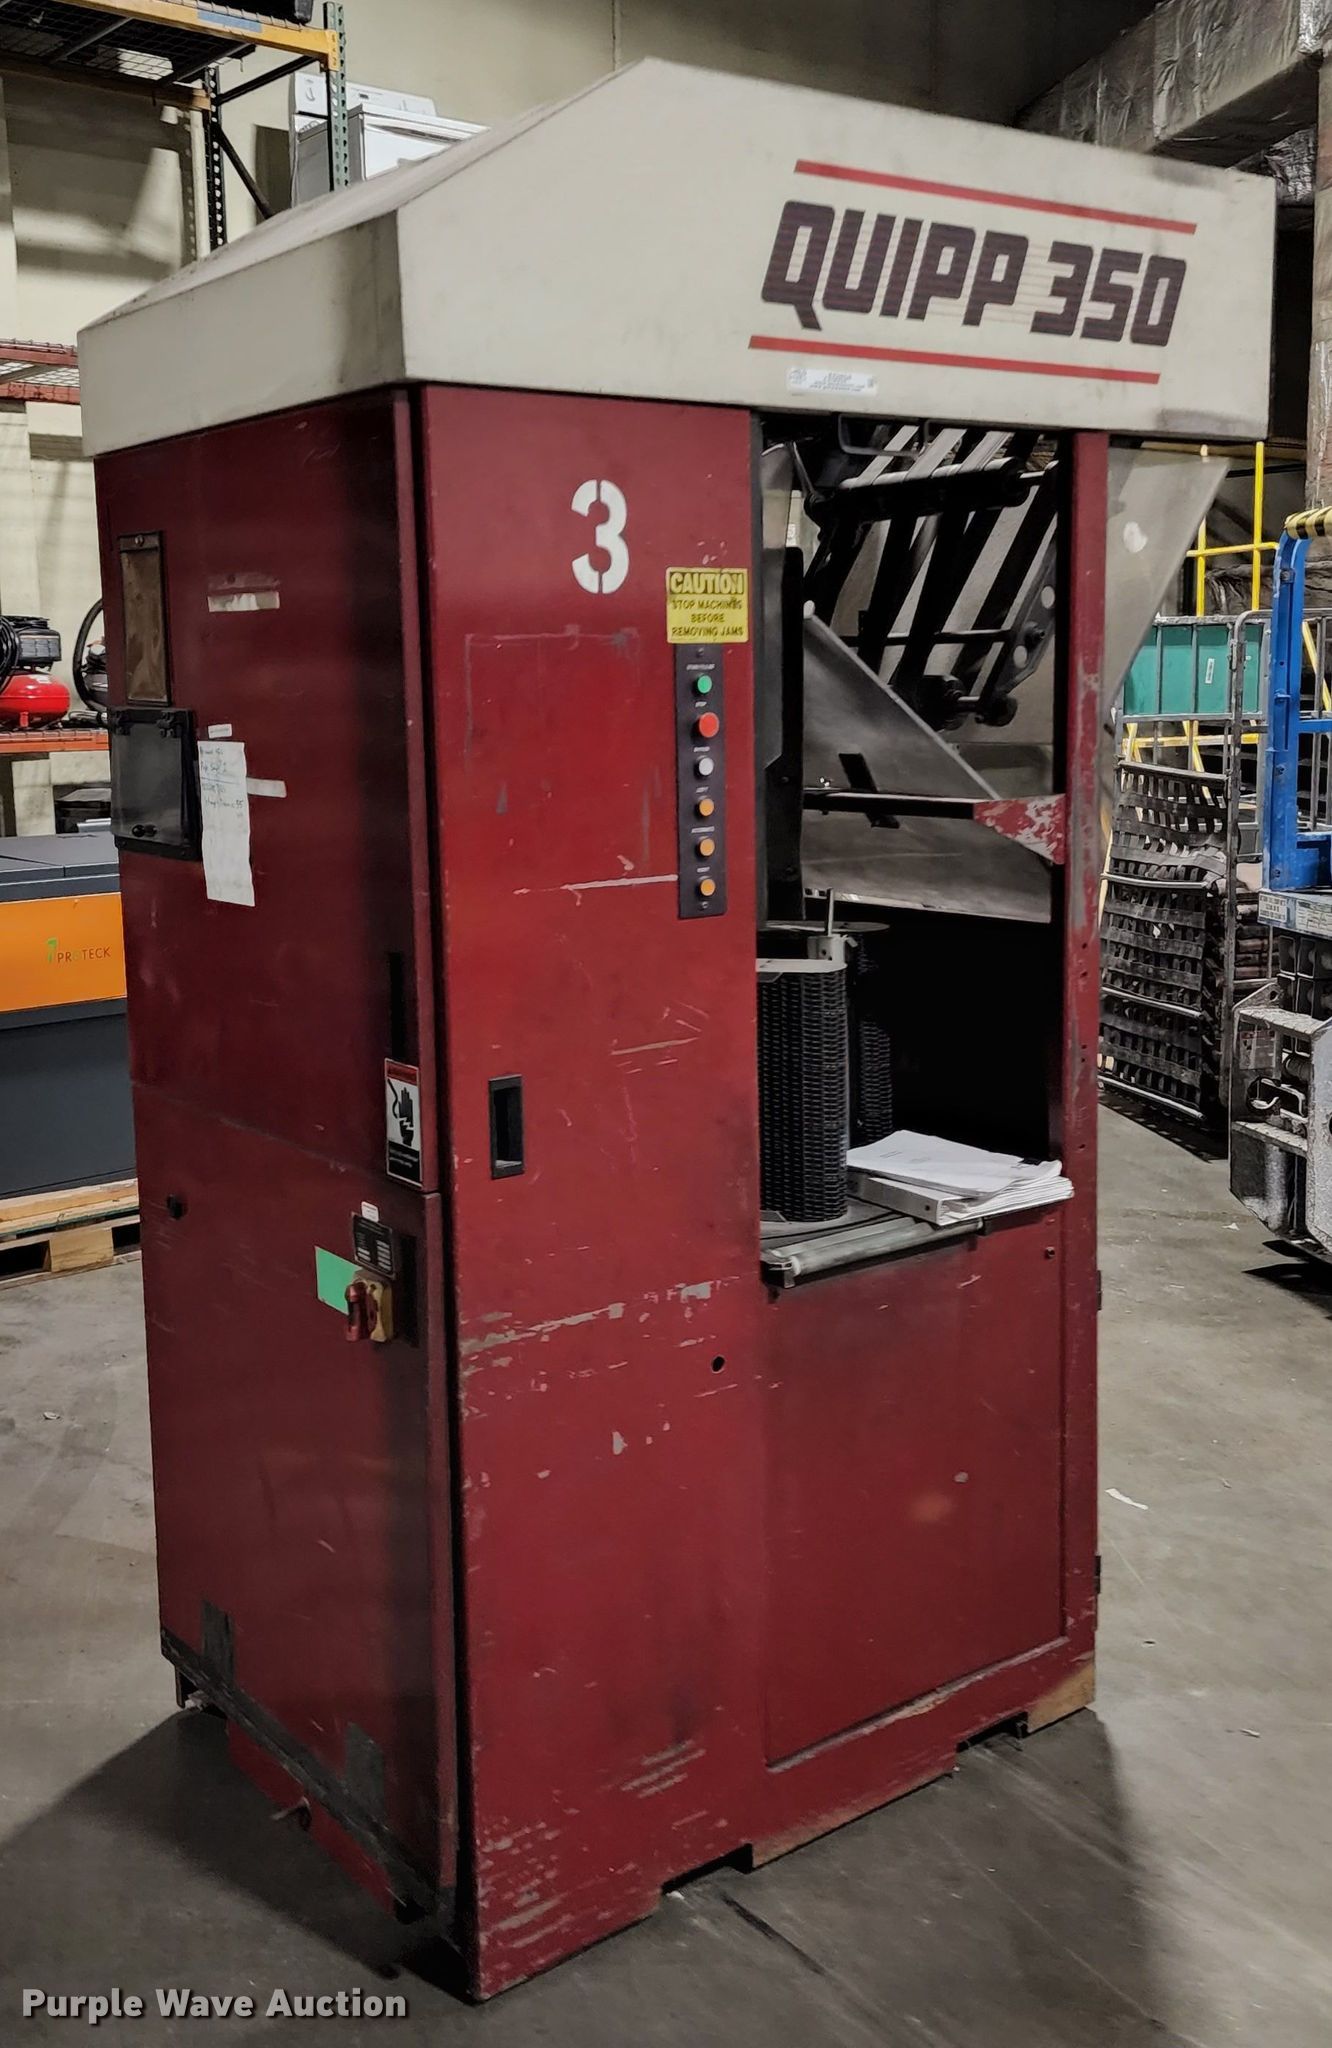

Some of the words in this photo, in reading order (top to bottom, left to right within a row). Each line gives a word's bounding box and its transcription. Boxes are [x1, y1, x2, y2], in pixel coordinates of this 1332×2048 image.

[761, 200, 1030, 331] QUIPP
[1029, 240, 1187, 347] 350
[571, 479, 630, 594] 3
[670, 572, 743, 594] CAUTION
[672, 599, 696, 610] STOP
[690, 612, 726, 624] BEFORE
[671, 626, 718, 637] REMOVING
[720, 626, 744, 637] JAMS
